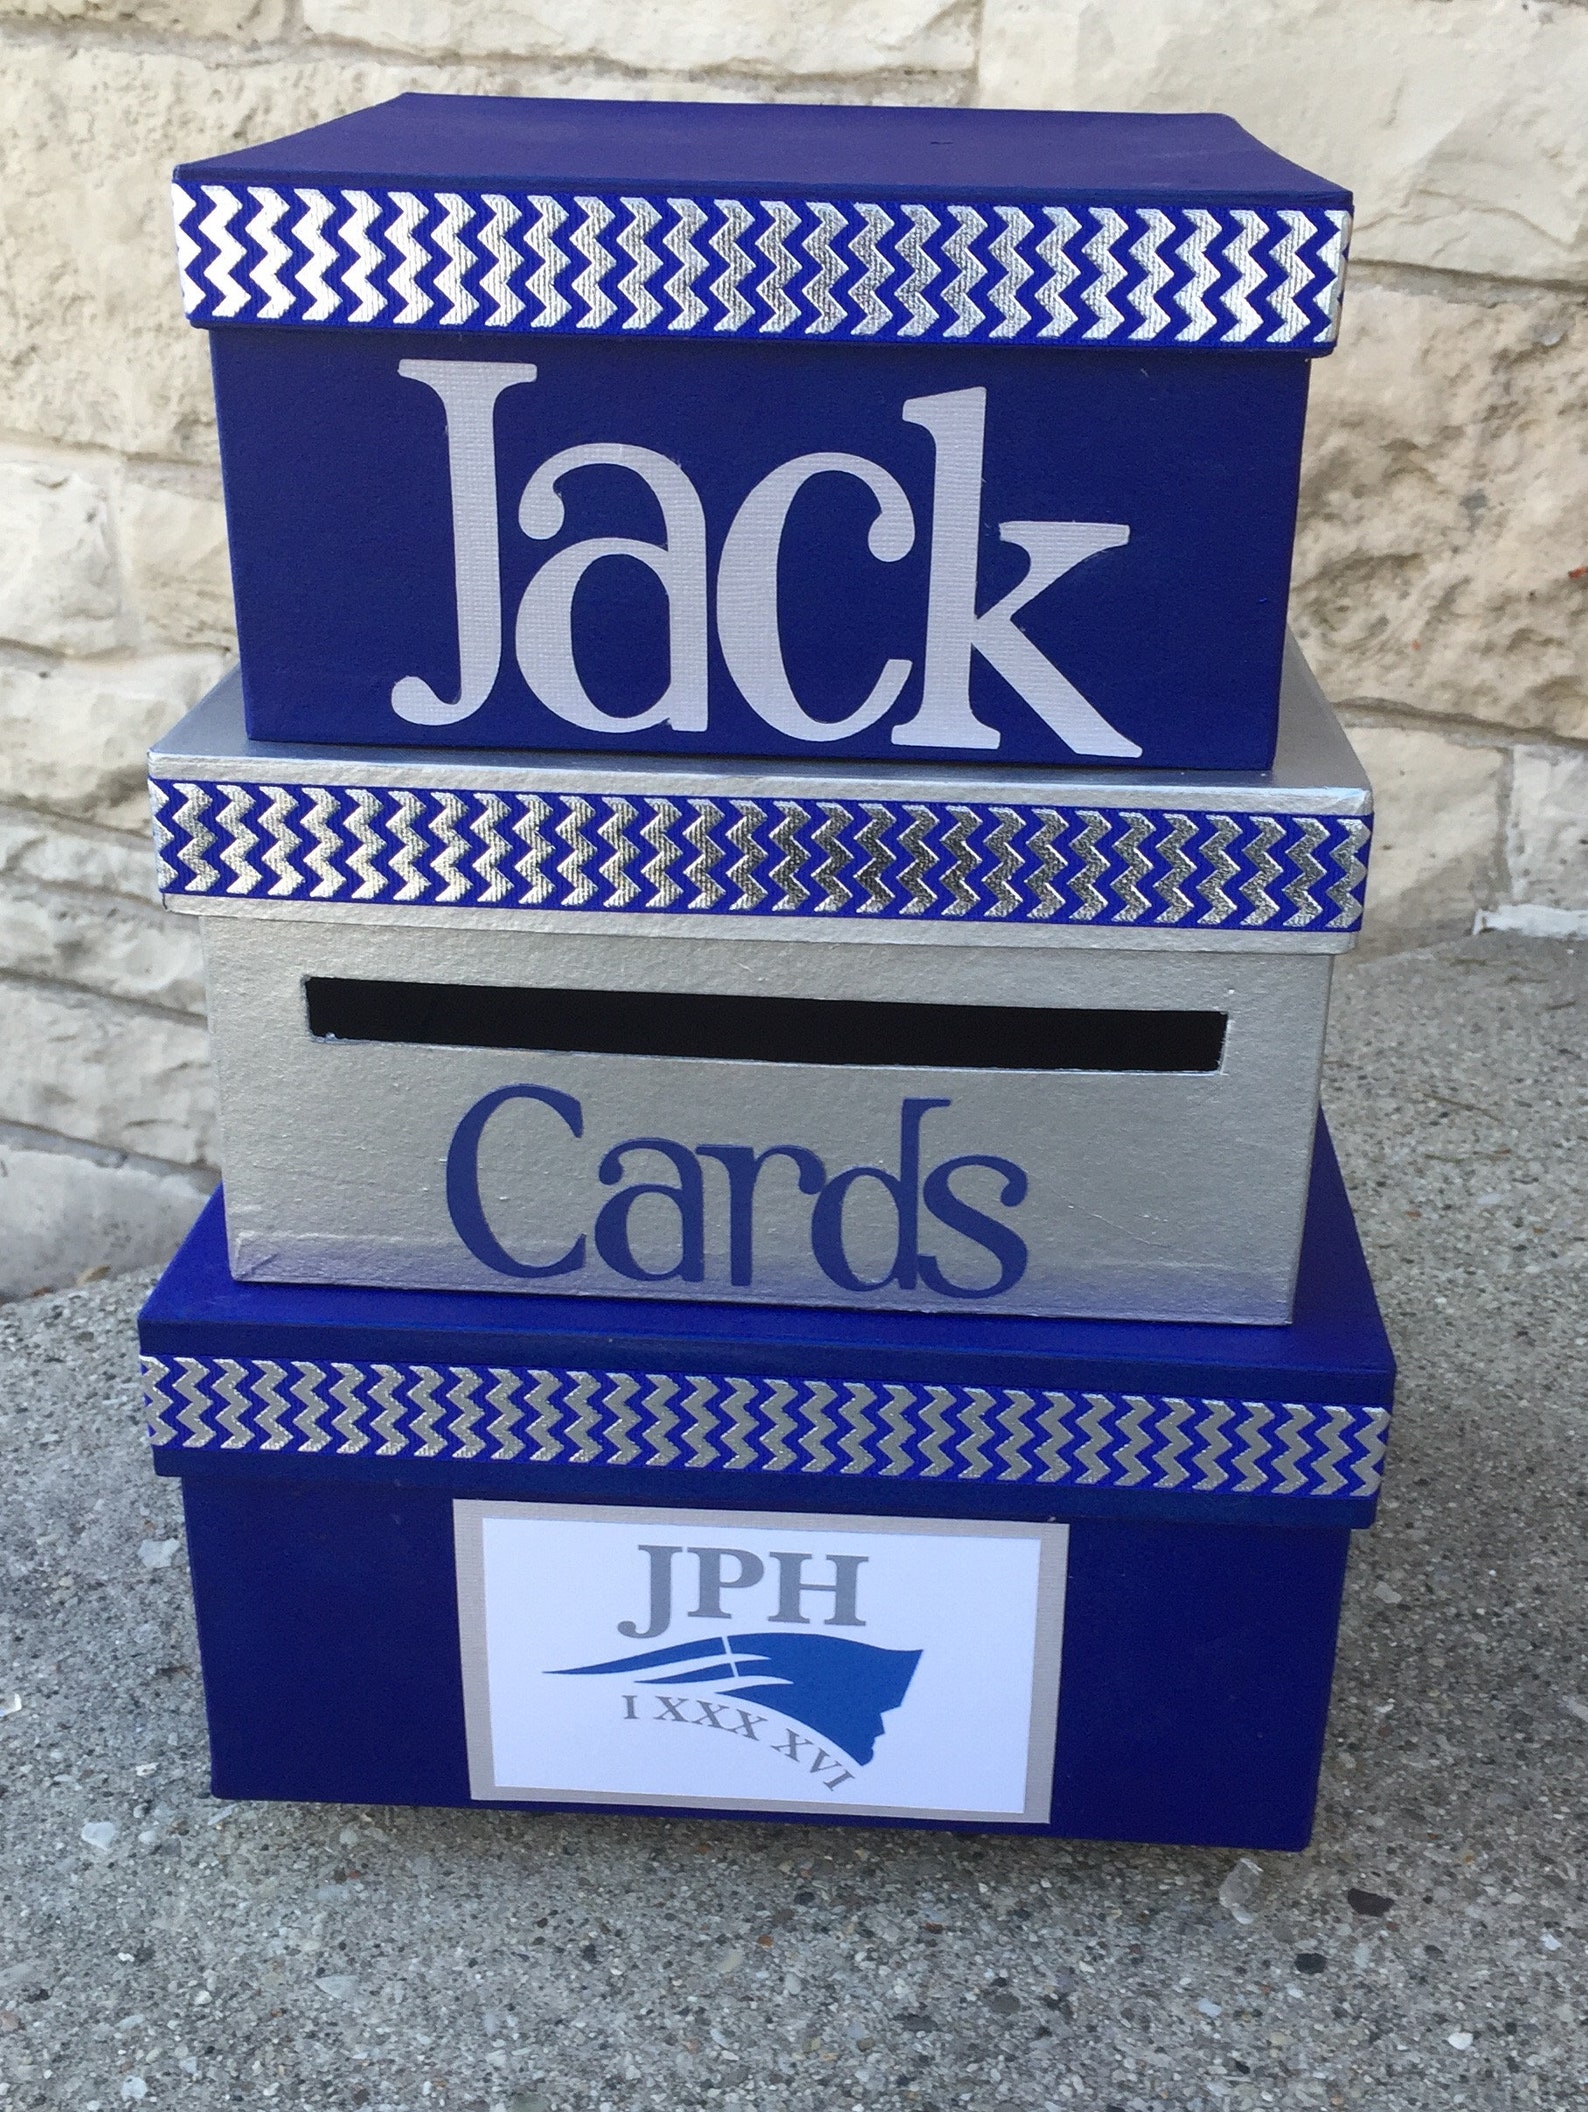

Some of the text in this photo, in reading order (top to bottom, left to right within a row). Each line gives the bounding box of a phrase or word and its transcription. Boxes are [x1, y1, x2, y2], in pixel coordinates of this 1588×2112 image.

[391, 359, 1142, 758] Jack
[446, 1083, 1027, 1299] Cards
[617, 1544, 869, 1639] JPH
[622, 1695, 856, 1792] I XXX XVI
